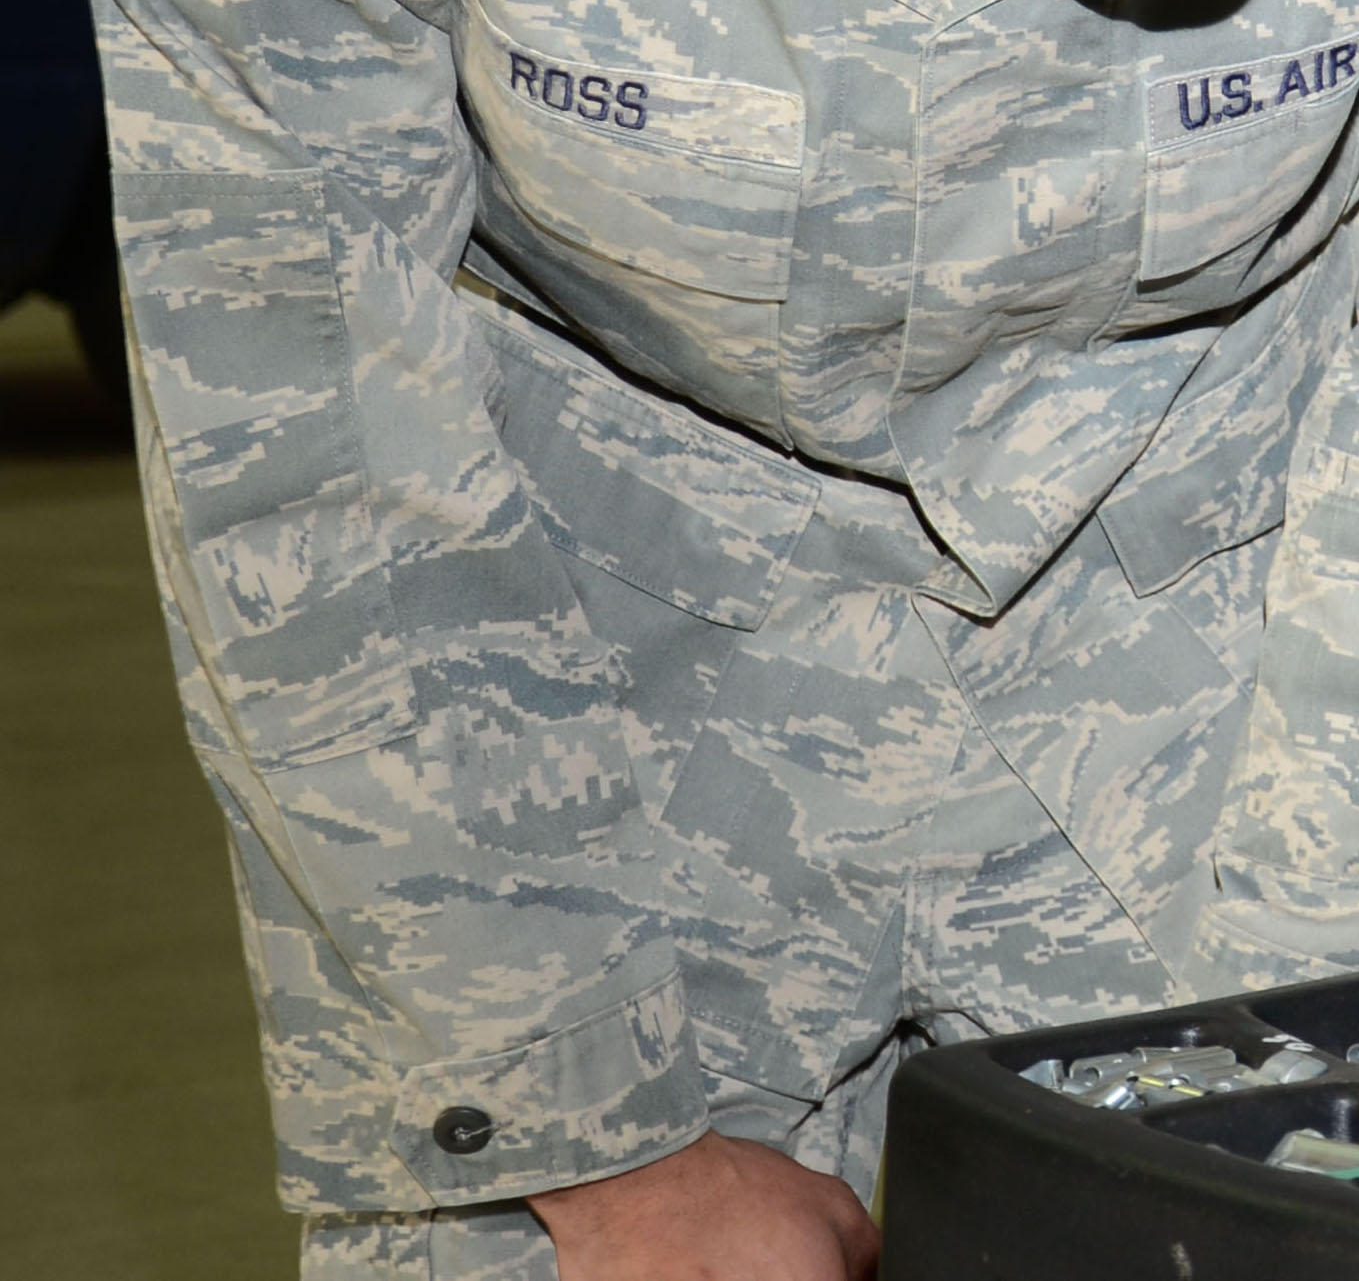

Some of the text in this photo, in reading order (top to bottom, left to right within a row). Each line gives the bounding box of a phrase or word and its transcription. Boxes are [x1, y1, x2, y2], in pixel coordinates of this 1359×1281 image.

[510, 52, 649, 131] ROSS
[1177, 41, 1358, 131] U.S. AIR
